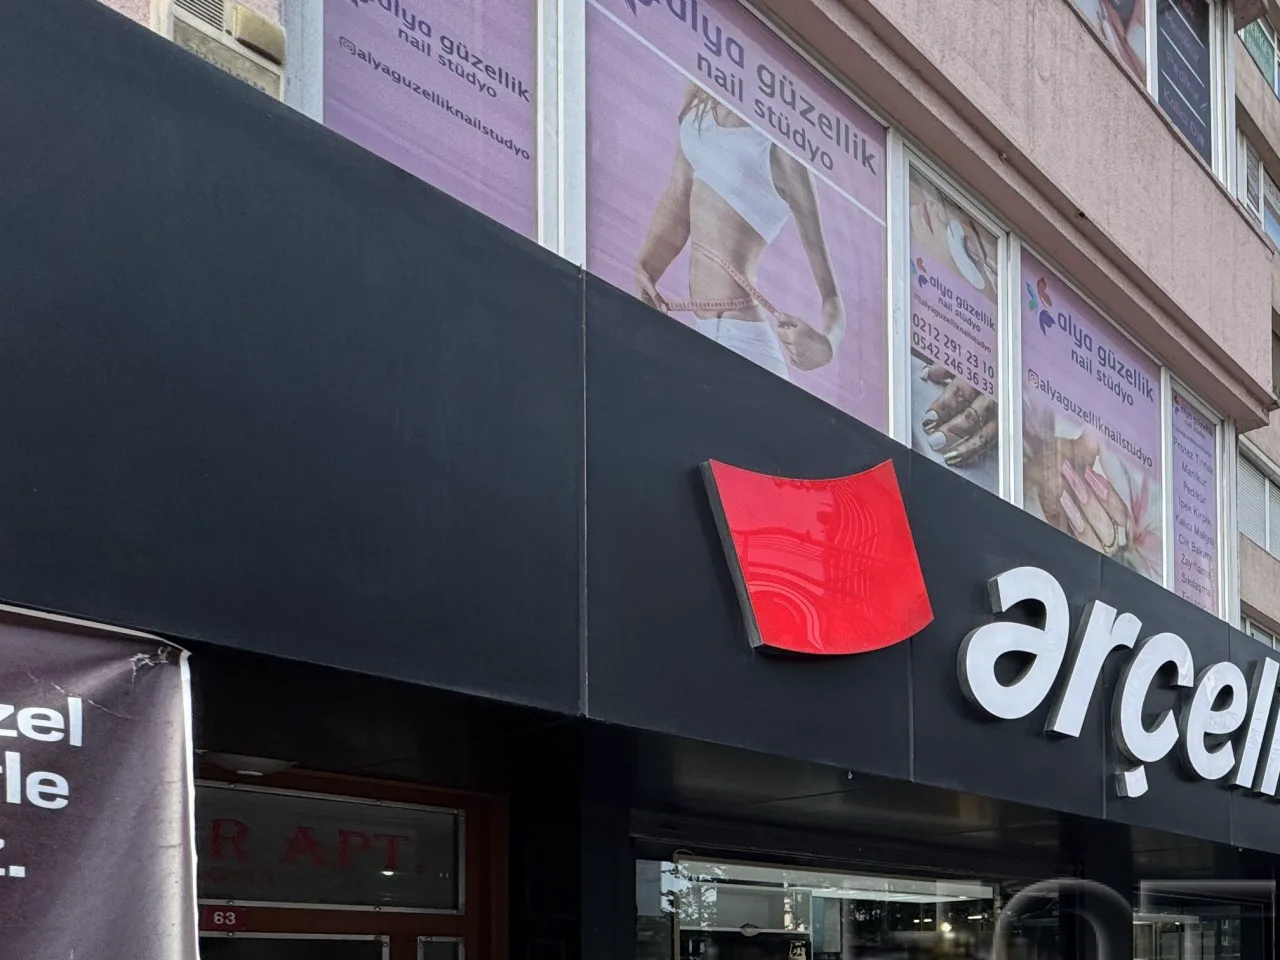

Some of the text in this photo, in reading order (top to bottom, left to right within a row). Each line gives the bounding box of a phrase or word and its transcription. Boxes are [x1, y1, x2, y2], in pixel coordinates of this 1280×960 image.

[398, 27, 497, 98] nail stüdyo
[439, 34, 530, 103] güzellik
[697, 52, 834, 171] nail stüdyo
[756, 63, 877, 175] güzellik
[930, 276, 996, 332] alya güzellik
[938, 298, 953, 312] nail
[913, 312, 994, 379] 0212 291 23 10
[913, 332, 994, 396] 0542 246 36 33
[1057, 312, 1154, 402] alya güzellik
[1071, 349, 1134, 406] nail stüdyo
[0, 751, 70, 809] le
[213, 911, 237, 926] 63
